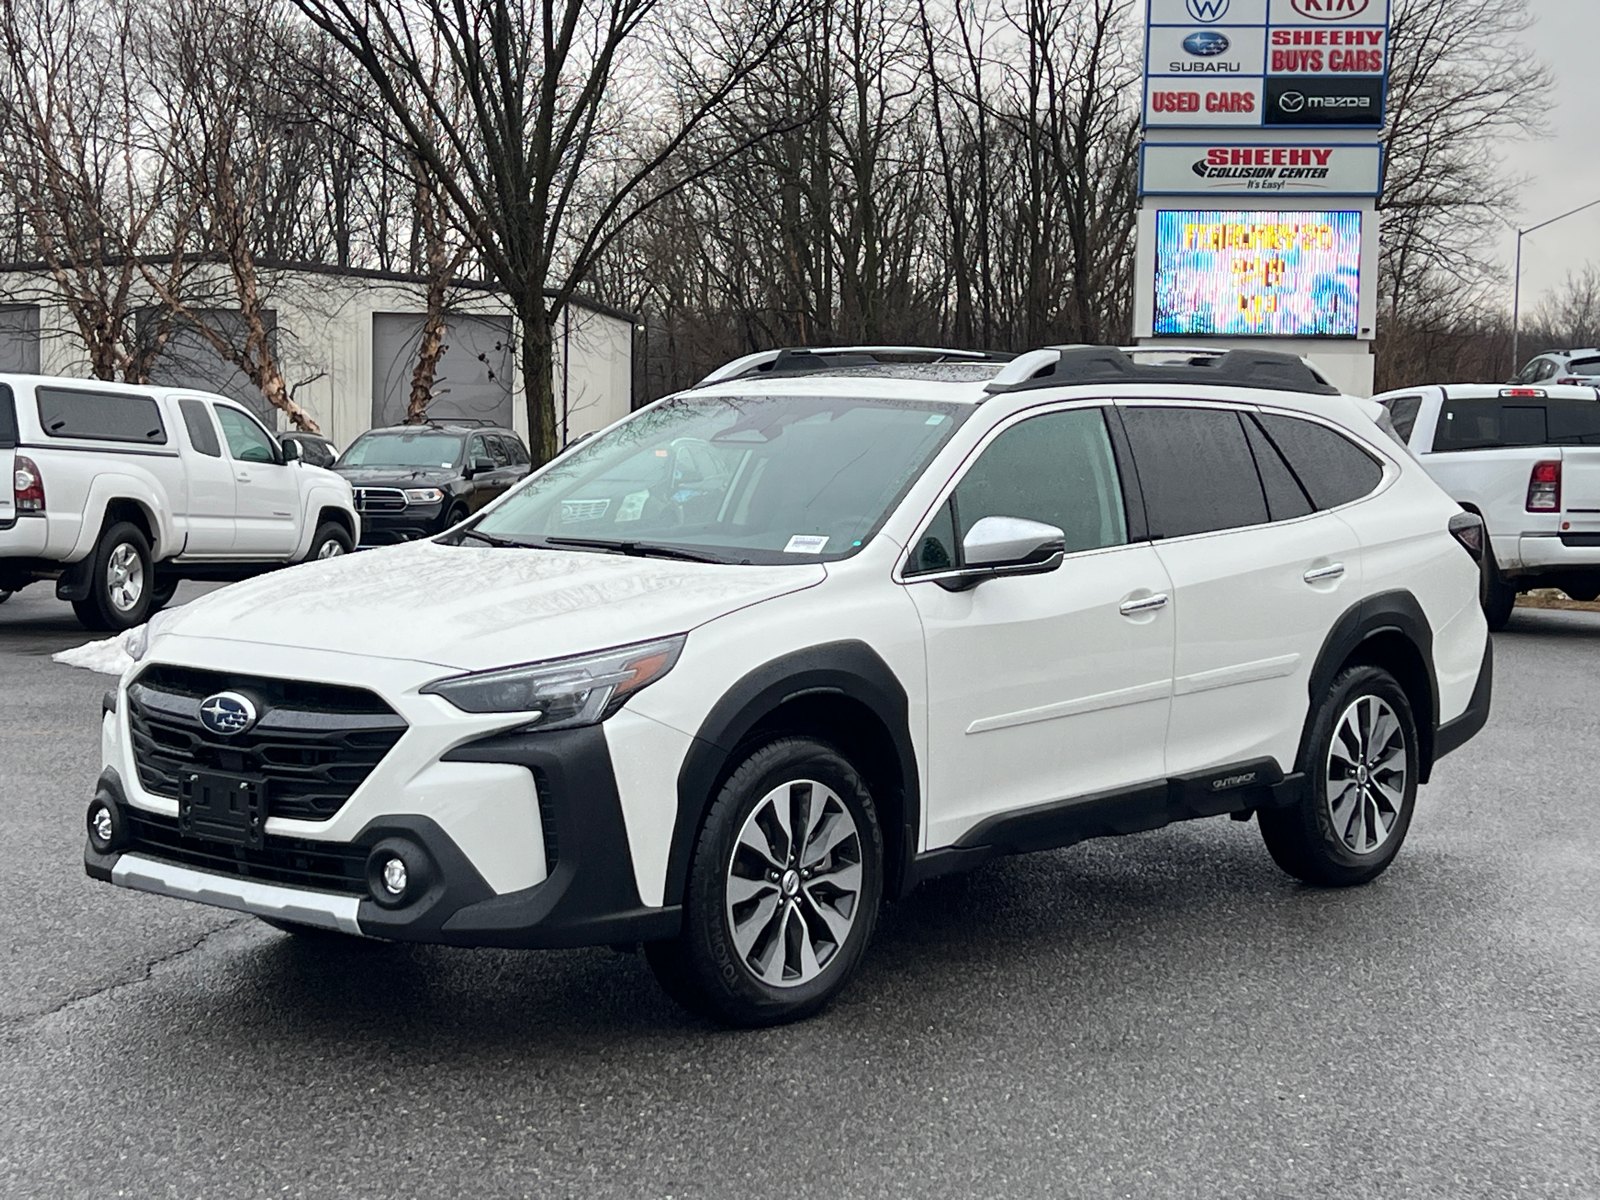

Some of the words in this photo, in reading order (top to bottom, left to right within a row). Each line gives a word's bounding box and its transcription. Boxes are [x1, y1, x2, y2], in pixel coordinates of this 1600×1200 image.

[1272, 31, 1383, 45] SHEEHY
[1169, 62, 1240, 72] SUBARU
[1271, 50, 1323, 72] BUYS
[1328, 50, 1382, 72] CARS
[1152, 92, 1200, 112] USED
[1205, 92, 1255, 112] CARS
[1207, 149, 1333, 165] SHEEHY
[1207, 168, 1276, 178] COLLISION
[1278, 168, 1329, 178] CENTER
[1247, 180, 1260, 188] It's
[1261, 180, 1285, 190] Easy!
[1213, 772, 1256, 788] OUTBACK
